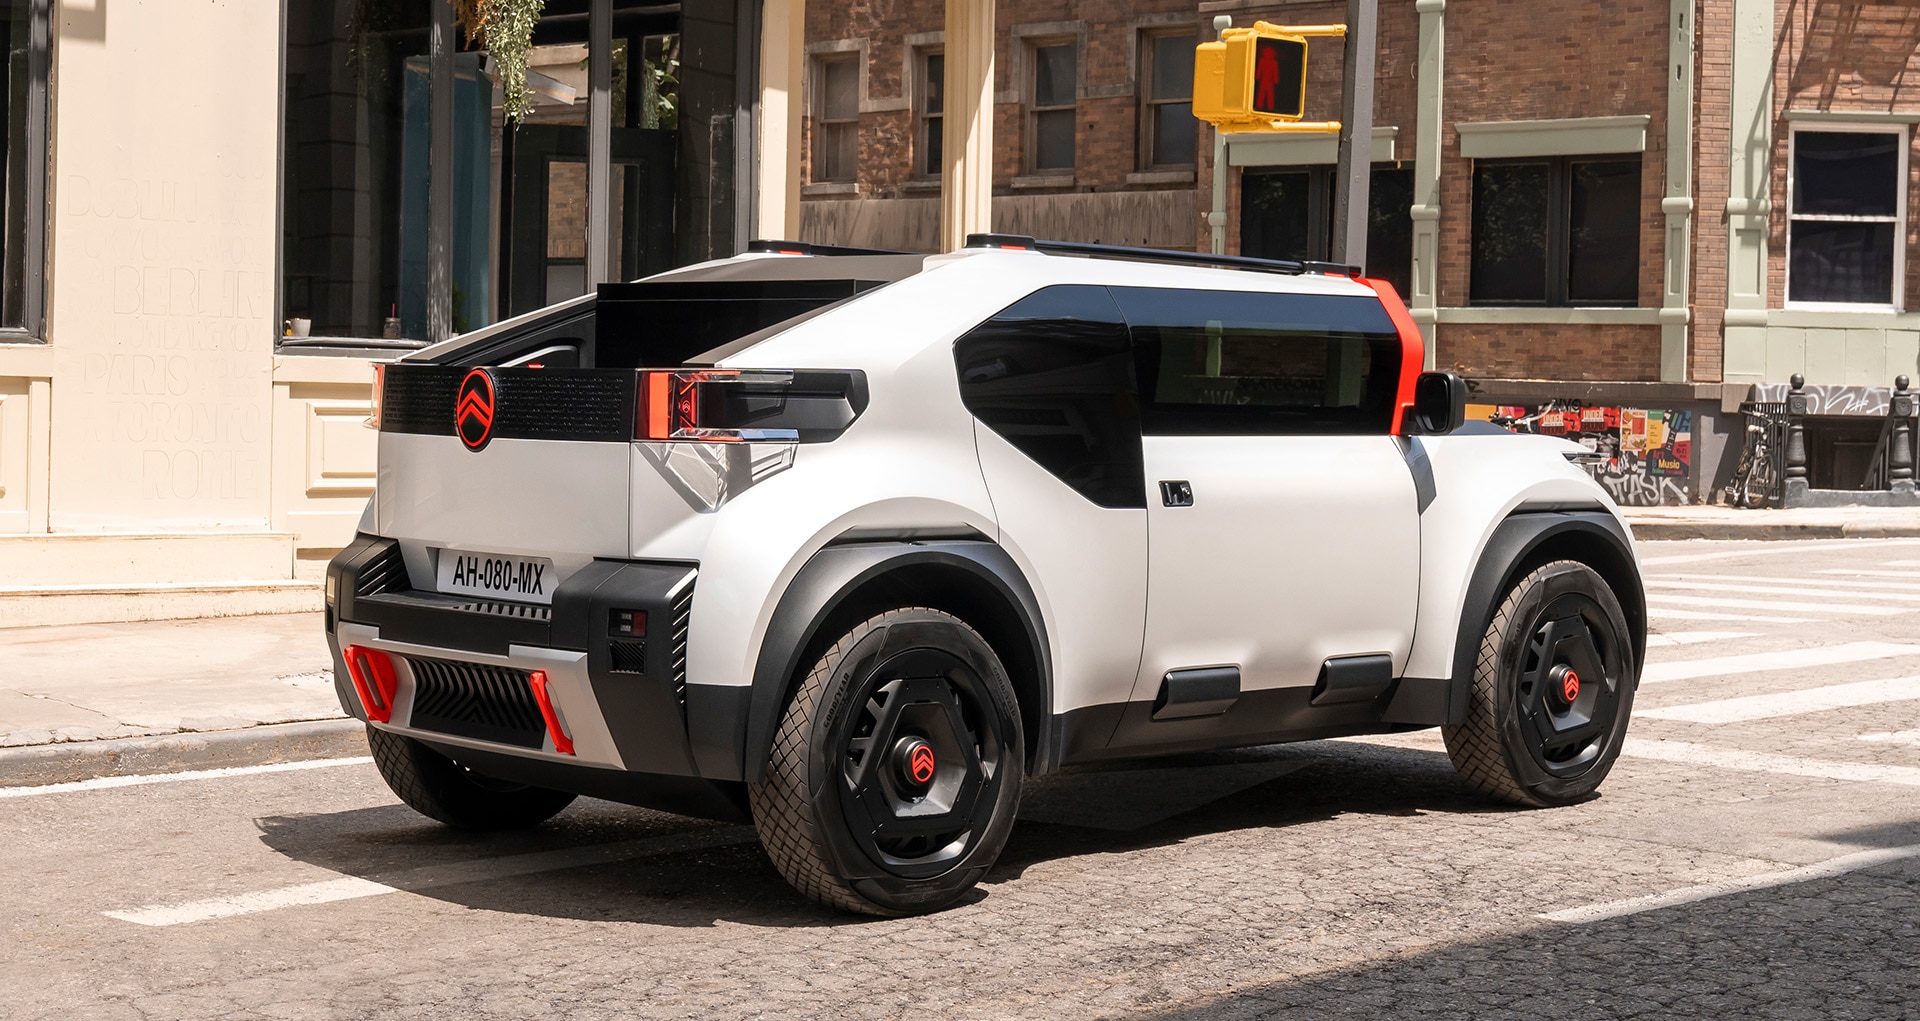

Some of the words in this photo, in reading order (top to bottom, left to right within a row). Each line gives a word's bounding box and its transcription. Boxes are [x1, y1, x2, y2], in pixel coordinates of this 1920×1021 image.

[113, 264, 265, 319] BERLIN
[84, 353, 190, 396] PARIS
[109, 400, 260, 444] TORONTO
[142, 448, 260, 500] ROME
[1658, 459, 1680, 469] Music
[452, 555, 545, 595] AH-080-MX
